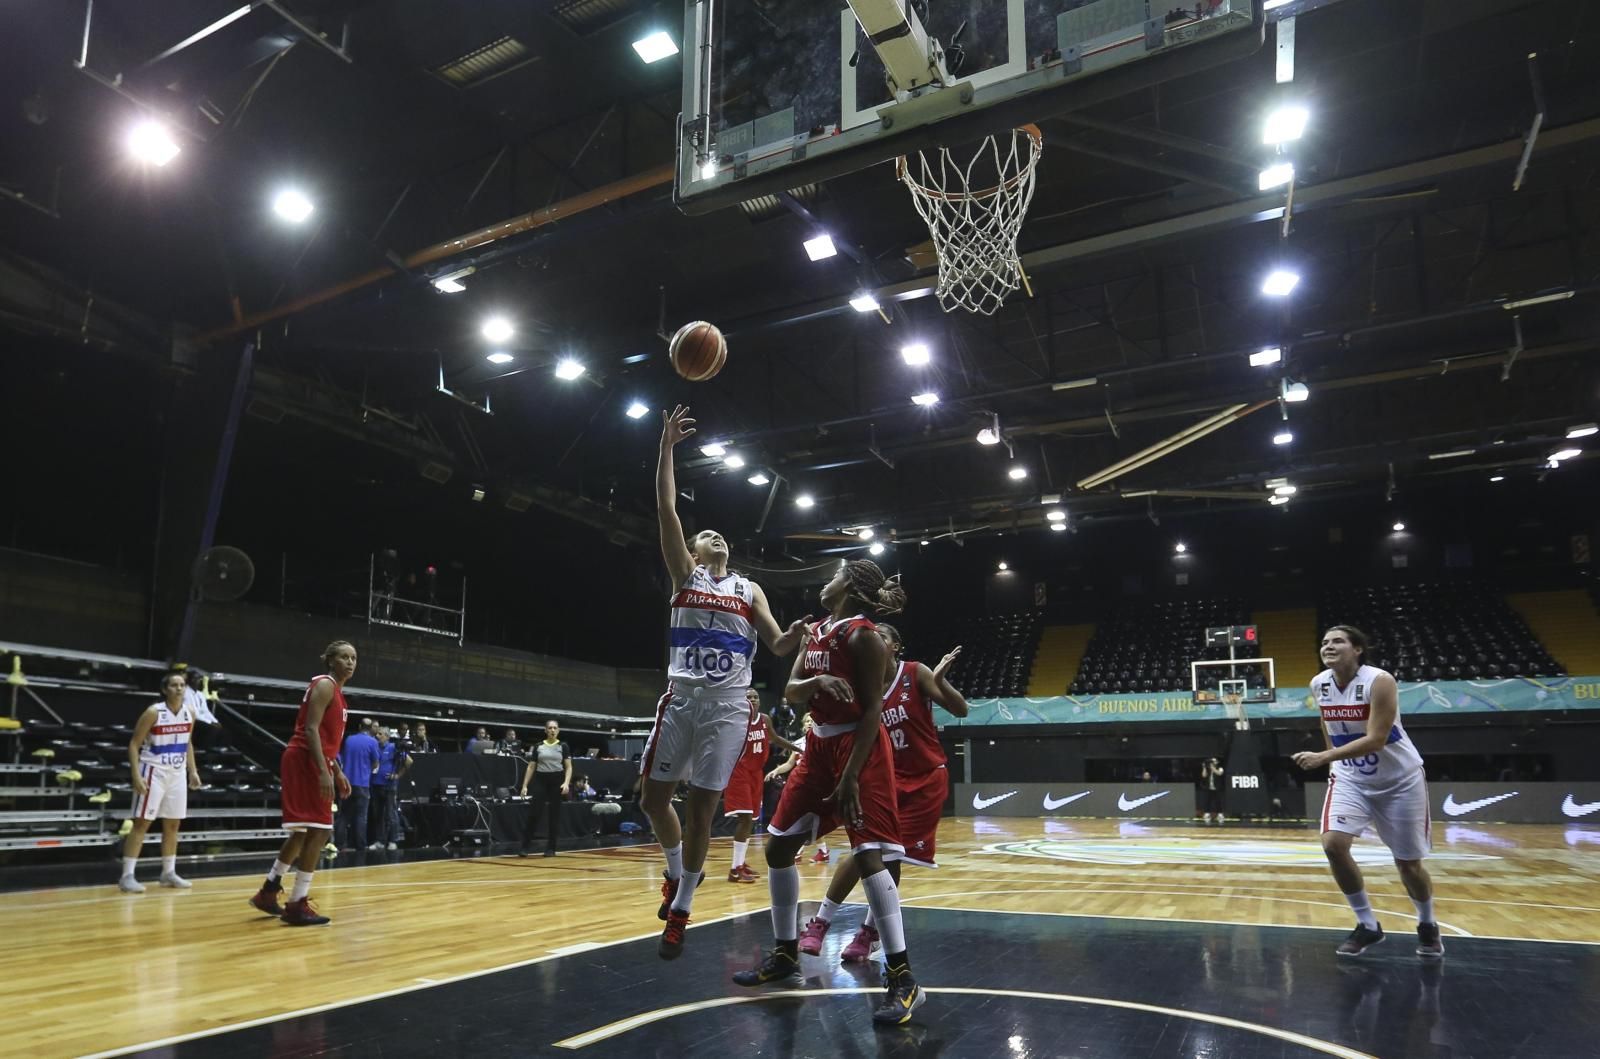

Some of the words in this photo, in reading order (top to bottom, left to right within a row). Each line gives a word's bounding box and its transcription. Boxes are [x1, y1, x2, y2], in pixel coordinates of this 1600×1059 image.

[687, 593, 742, 610] PARAGUAY
[1246, 628, 1255, 641] 6
[804, 651, 830, 671] CUBA
[1098, 699, 1158, 713] BUENOS
[881, 704, 909, 728] UBA
[1323, 708, 1364, 718] PARAGUAY
[748, 730, 765, 741] CUBA
[890, 728, 908, 750] 12
[753, 742, 763, 754] 14
[1231, 775, 1259, 788] FIBA
